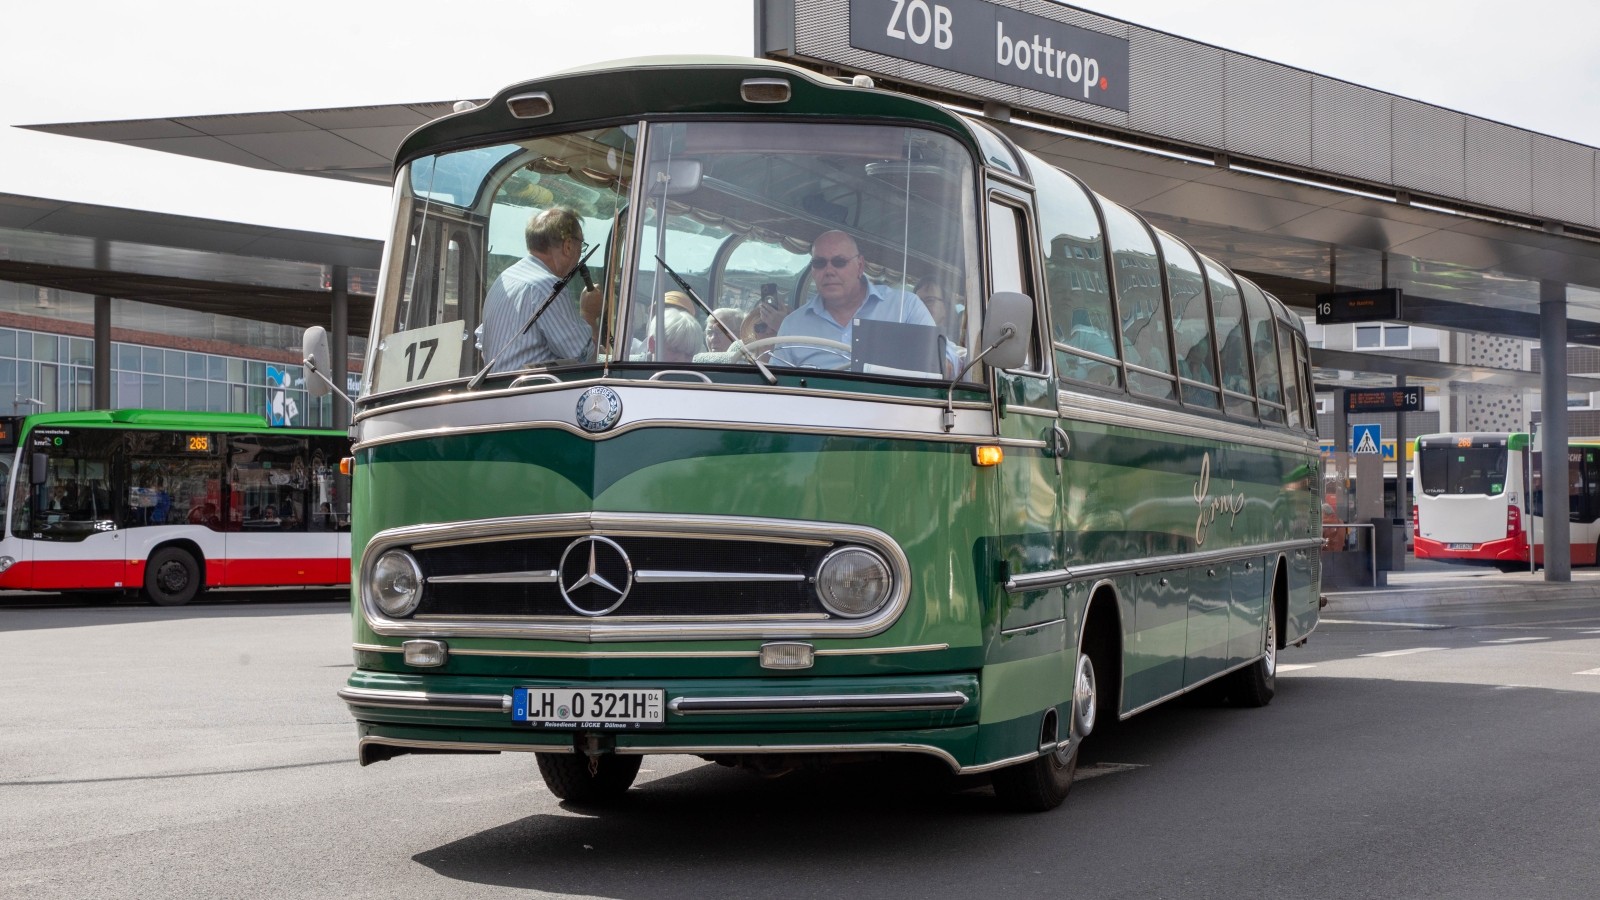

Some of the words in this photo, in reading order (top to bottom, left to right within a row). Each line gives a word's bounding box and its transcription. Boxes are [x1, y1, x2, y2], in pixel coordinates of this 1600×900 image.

[886, 0, 953, 50] ZOB
[997, 21, 1108, 98] bottrop.
[1317, 302, 1331, 315] 16
[404, 338, 439, 382] 17
[582, 387, 612, 399] MERCEDES
[1404, 393, 1417, 405] 15
[190, 437, 208, 450] 265
[648, 693, 659, 701] 04
[528, 692, 555, 718] LH
[590, 692, 646, 718] 321H
[517, 708, 523, 716] D
